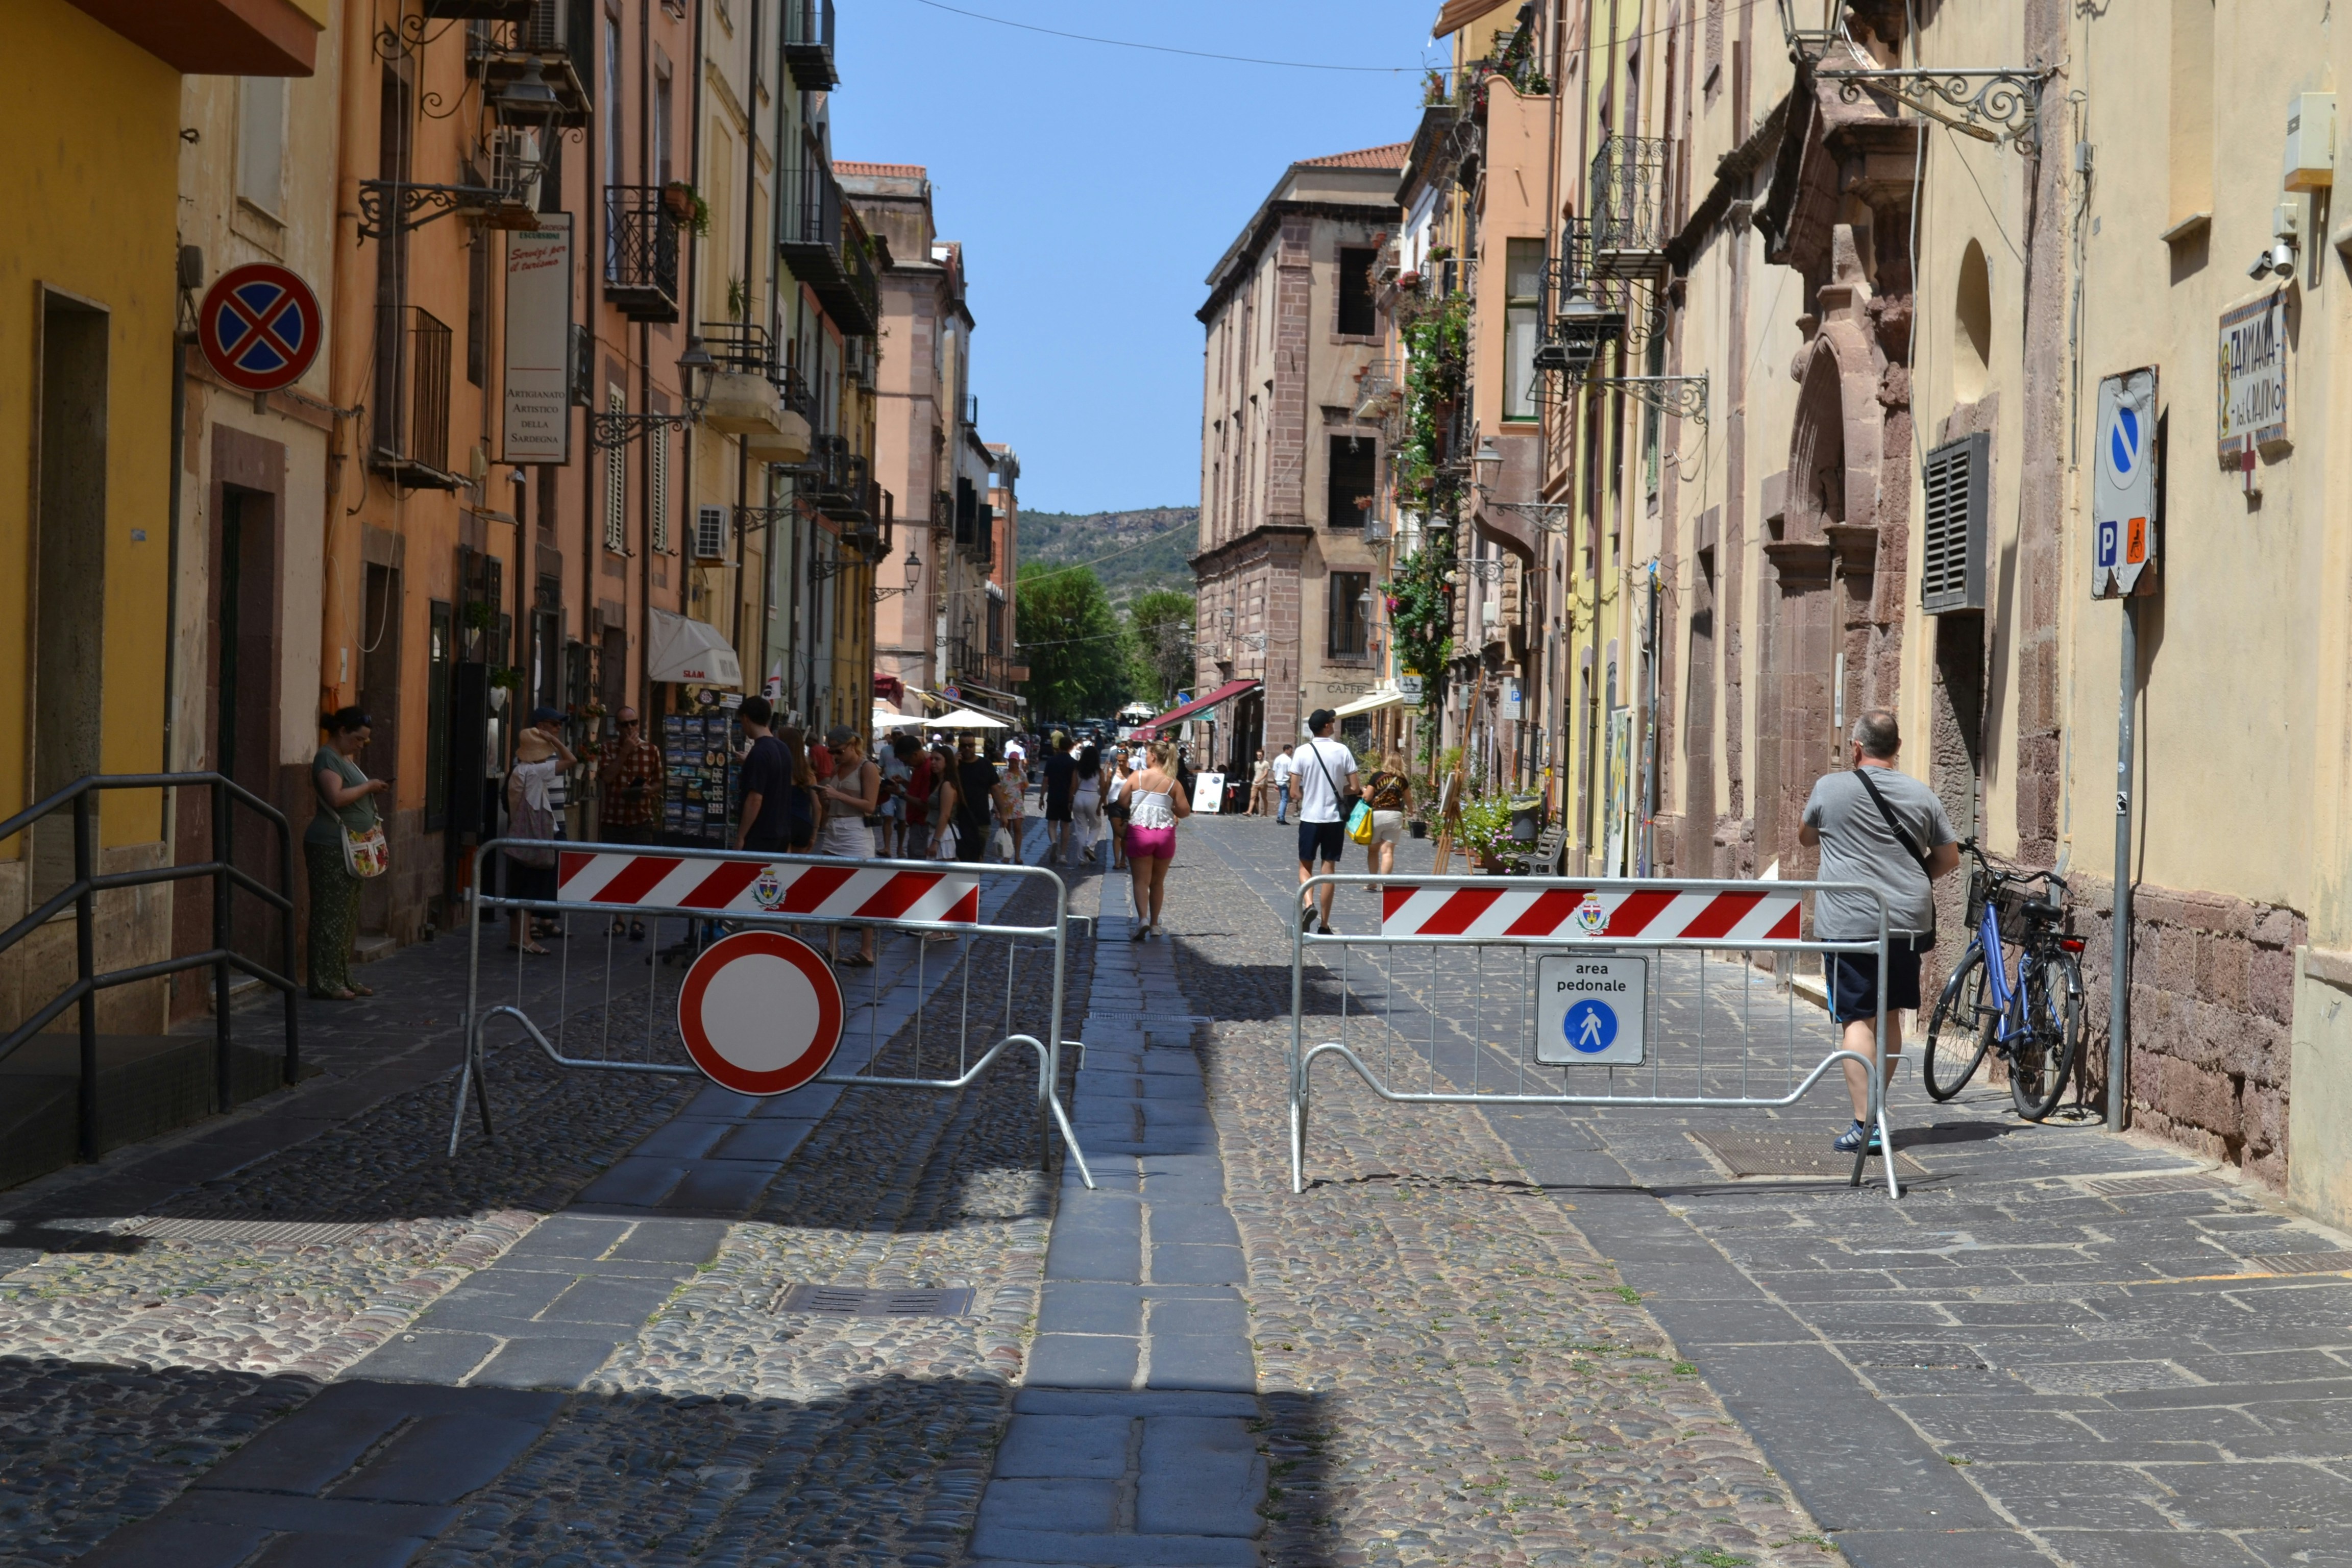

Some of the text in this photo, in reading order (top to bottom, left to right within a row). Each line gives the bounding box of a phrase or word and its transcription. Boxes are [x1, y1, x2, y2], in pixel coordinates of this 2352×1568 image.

[510, 245, 567, 260] Servizi per
[509, 259, 559, 272] il turismo
[2231, 315, 2275, 379] FARMACIA
[506, 388, 566, 399] ARTIGIANATO
[512, 404, 559, 413] ARTISTICO
[511, 433, 558, 444] SARDEGNA
[2102, 527, 2114, 562] P
[683, 670, 705, 679] SLAM
[1576, 965, 1608, 974] area
[1557, 979, 1626, 992] pedonale
